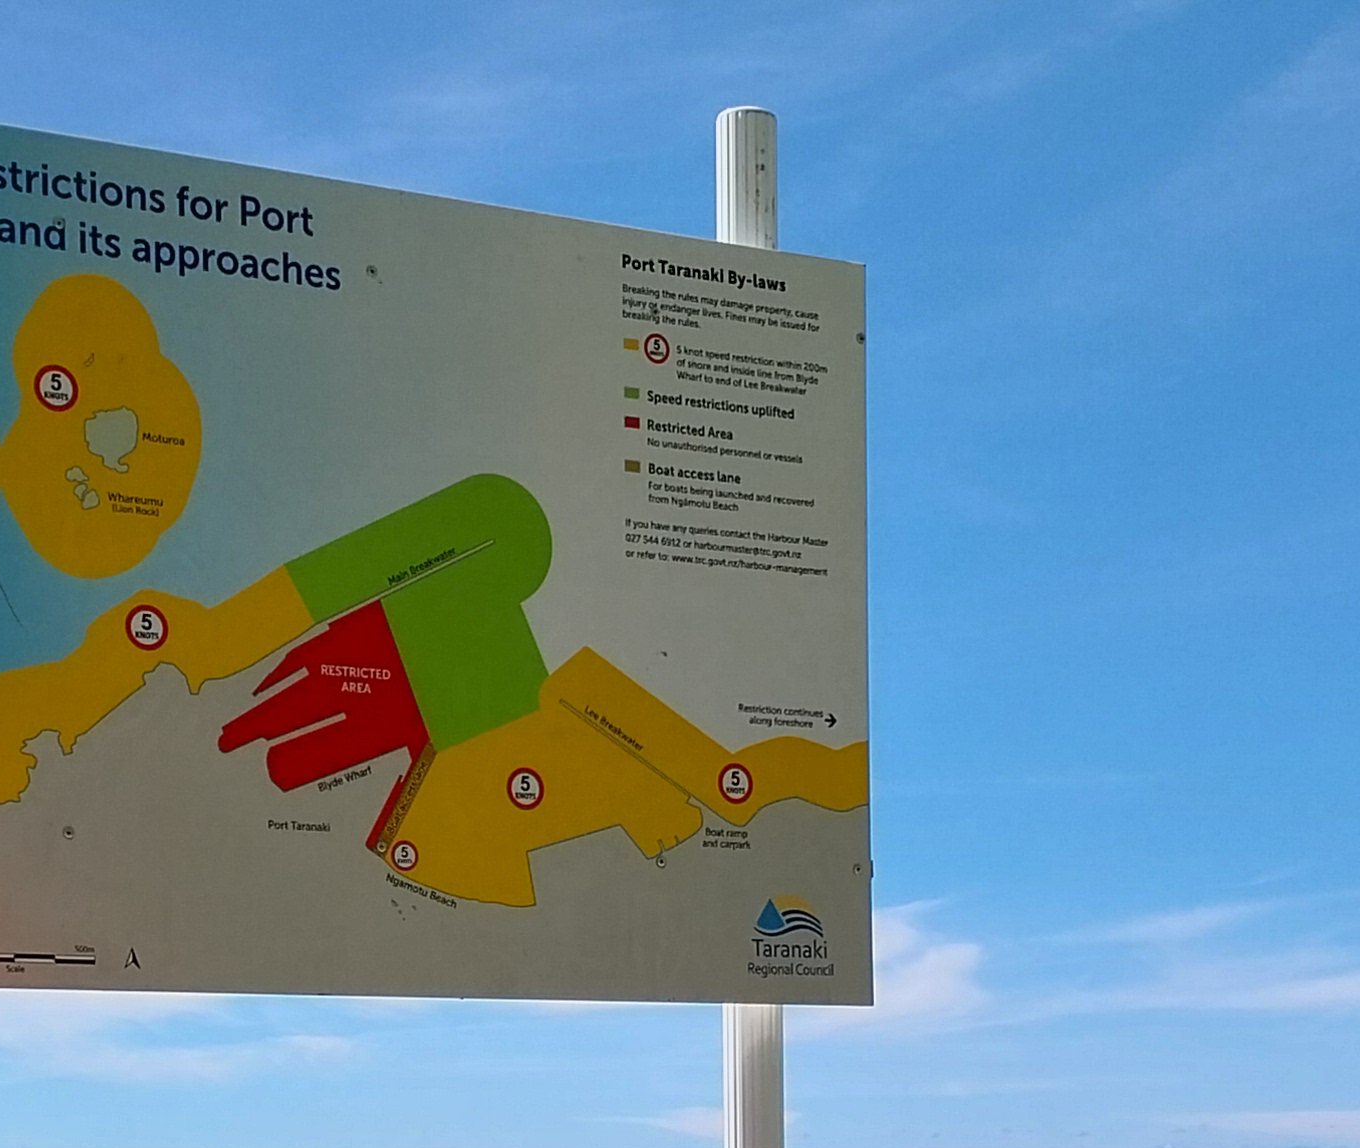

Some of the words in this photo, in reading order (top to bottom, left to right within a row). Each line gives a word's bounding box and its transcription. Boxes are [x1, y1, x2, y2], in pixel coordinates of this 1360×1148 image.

[175, 185, 228, 222] for
[240, 194, 314, 237] Port
[78, 222, 122, 259] its
[131, 236, 342, 291] approaches
[621, 253, 655, 273] Port
[658, 258, 724, 283] Taranaki
[728, 269, 786, 293] By-laws
[622, 283, 660, 300] Breaking
[661, 290, 676, 300] the
[678, 293, 699, 303] rules
[700, 297, 719, 308] may
[720, 299, 754, 312] damage
[755, 304, 793, 318] property,
[794, 310, 819, 320] cause
[622, 309, 660, 325] breaking
[661, 315, 676, 325] the
[677, 318, 701, 329] rules.
[660, 303, 700, 317] endanger
[702, 307, 723, 319] lives.
[725, 311, 747, 323] Fines
[748, 315, 766, 327] may
[767, 317, 779, 327] be
[780, 319, 806, 331] issued
[807, 323, 820, 332] for
[653, 339, 661, 351] 5
[676, 344, 682, 354] 5
[683, 346, 704, 357] knot
[705, 350, 730, 361] speed
[731, 353, 775, 366] restriction
[776, 360, 802, 370] within
[803, 362, 828, 374] 200m
[676, 359, 686, 368] of
[687, 360, 711, 371] shore
[713, 364, 729, 374] and
[730, 366, 756, 377] inside
[756, 369, 772, 379] line
[774, 371, 794, 382] from
[795, 373, 819, 386] Blyde
[50, 373, 63, 391] 5
[676, 370, 702, 382] Wharf
[704, 374, 713, 384] to
[715, 377, 732, 387] end
[732, 379, 742, 388] of
[743, 379, 759, 390] Lee
[760, 381, 807, 396] Breakwater
[44, 391, 70, 401] KNOTS
[647, 390, 682, 406] Speed
[684, 396, 749, 414] restrictions
[751, 403, 795, 420] uplifted
[647, 419, 706, 438] Restricted
[707, 425, 734, 441] Area
[142, 432, 186, 447] Moturoa
[647, 437, 661, 448] No
[662, 440, 719, 455] unauthorised
[719, 447, 762, 461] personnel
[763, 452, 773, 460] or
[773, 454, 803, 464] vessels
[648, 462, 675, 477] Boat
[677, 468, 715, 482] access
[717, 470, 742, 485] lane
[107, 491, 164, 507] Whareumu
[648, 480, 663, 491] For
[664, 482, 689, 494] boats
[690, 485, 714, 499] being
[715, 488, 754, 502] launched
[755, 493, 772, 504] and
[773, 496, 815, 508] recovered
[648, 494, 670, 505] from
[712, 500, 739, 512] Beach
[112, 504, 134, 515] (Lion
[136, 506, 160, 518] Rock)
[625, 518, 631, 528] If
[632, 520, 649, 530] you
[650, 521, 671, 532] have
[672, 524, 688, 535] any
[720, 529, 752, 540] contact
[752, 531, 767, 541] the
[767, 532, 801, 545] Harbour
[802, 536, 829, 548] Master
[625, 533, 641, 544] 027
[643, 535, 659, 545] 544
[661, 537, 682, 549] 6912
[683, 541, 693, 549] or
[693, 540, 802, 559] harbourmaster@trc.govt.nz
[625, 550, 636, 558] or
[636, 551, 657, 560] refer
[658, 553, 670, 562] to:
[387, 570, 410, 586] Main
[408, 547, 456, 575] Breakwater
[140, 613, 153, 631] 5
[134, 631, 160, 640] KNOTS
[320, 664, 391, 680] RESTRICTED
[340, 681, 372, 694] AREA
[738, 703, 783, 715] Restriction
[783, 708, 824, 718] continues
[584, 705, 599, 720] Lee
[600, 715, 644, 752] Breakwater
[749, 716, 772, 728] along
[773, 717, 814, 729] foreshore
[317, 777, 344, 793] Blyde
[343, 765, 373, 783] Wharf
[520, 775, 531, 792] 5
[731, 770, 741, 787] 5
[514, 792, 537, 800] KNOTS
[725, 787, 746, 795] KNOTS
[267, 819, 288, 831] Port
[290, 820, 331, 833] Taranaki
[705, 827, 724, 838] Boat
[725, 830, 748, 840] ramp
[400, 846, 409, 859] 5
[702, 839, 719, 849] and
[720, 840, 751, 851] carpark
[429, 890, 457, 910] Beach
[751, 938, 829, 960] Taranaki
[5, 964, 26, 974] Scale
[747, 961, 793, 977] Regional
[795, 963, 835, 977] Council
